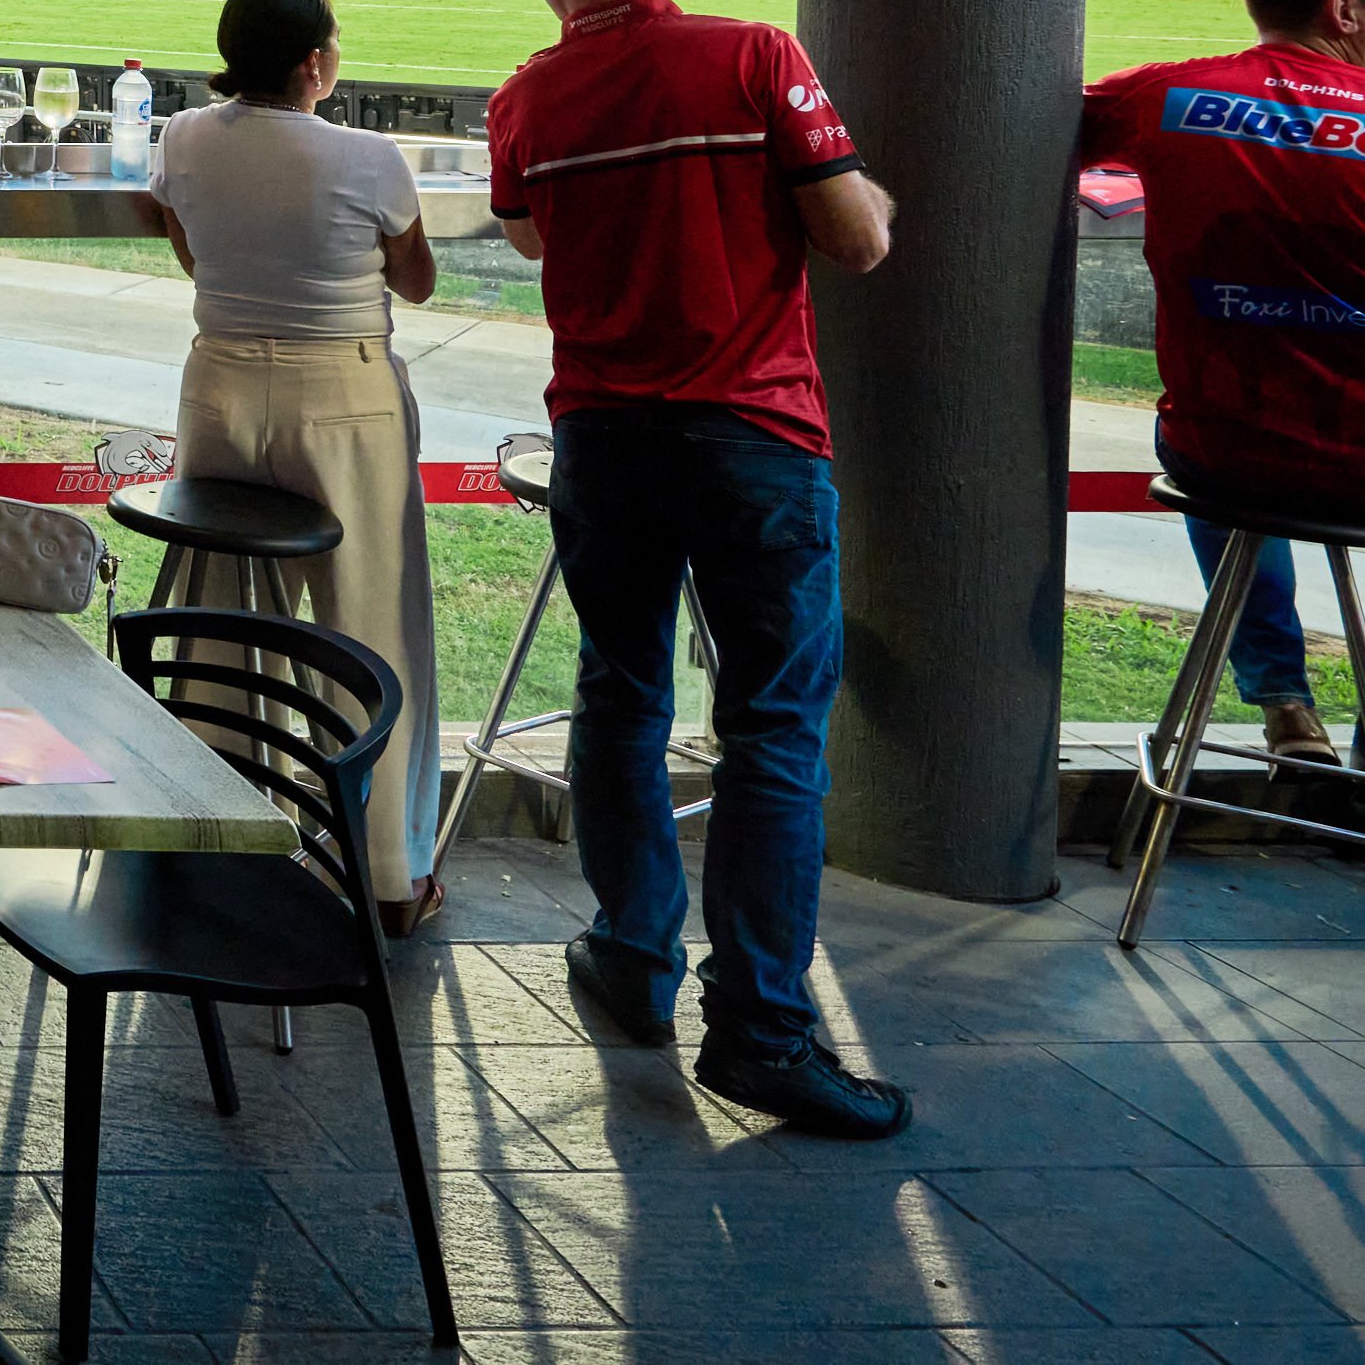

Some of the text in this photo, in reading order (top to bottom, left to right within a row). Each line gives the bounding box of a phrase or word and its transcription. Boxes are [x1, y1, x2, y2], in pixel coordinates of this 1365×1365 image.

[576, 4, 632, 27] INTERSPORT
[1264, 78, 1364, 101] DOLPHINS
[1179, 93, 1365, 156] BlueB
[1213, 284, 1294, 318] Foxi
